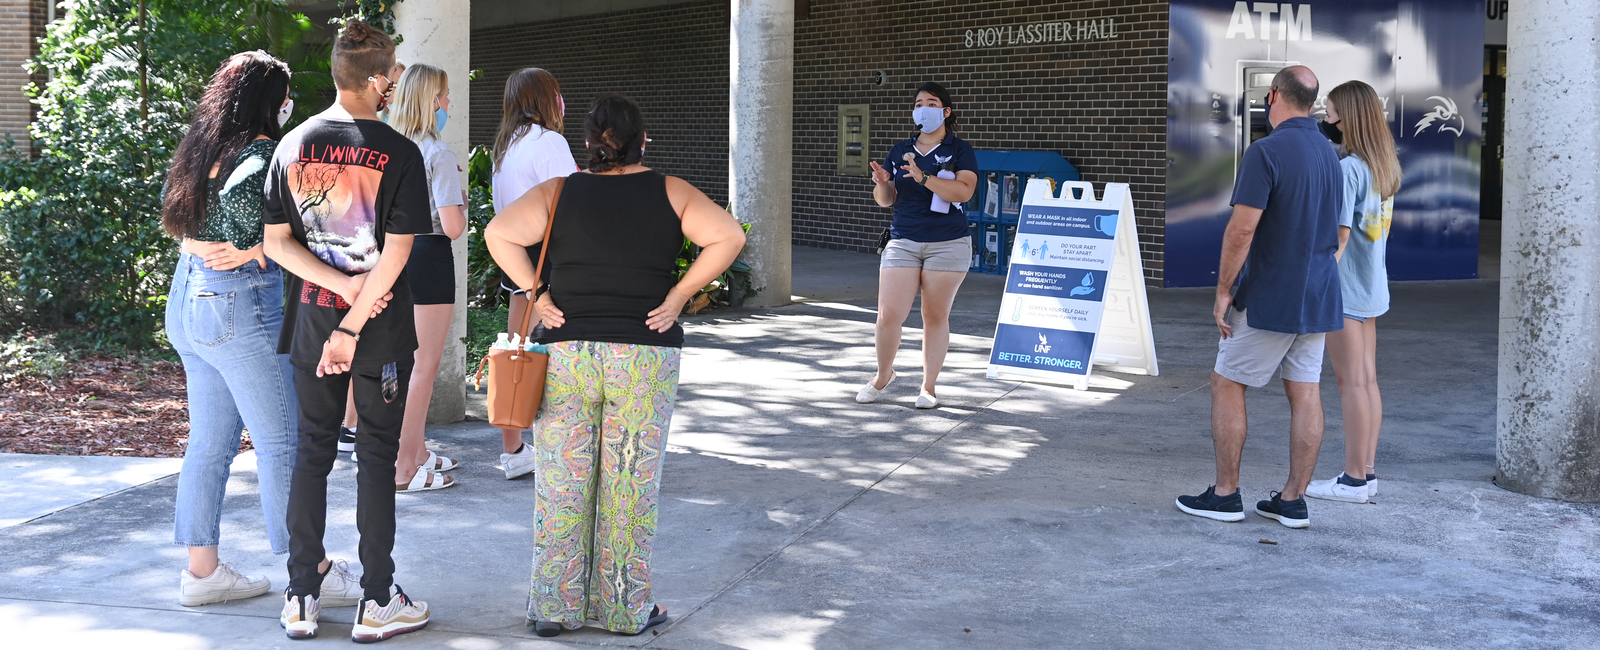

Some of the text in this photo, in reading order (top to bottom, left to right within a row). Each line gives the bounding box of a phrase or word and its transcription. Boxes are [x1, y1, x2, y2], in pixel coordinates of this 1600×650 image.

[965, 18, 1118, 48] 8 ROY LASSITER HALL
[1225, 1, 1312, 41] ATM
[1034, 344, 1052, 353] UNF
[998, 352, 1083, 370] BETTER. STRONGER.
